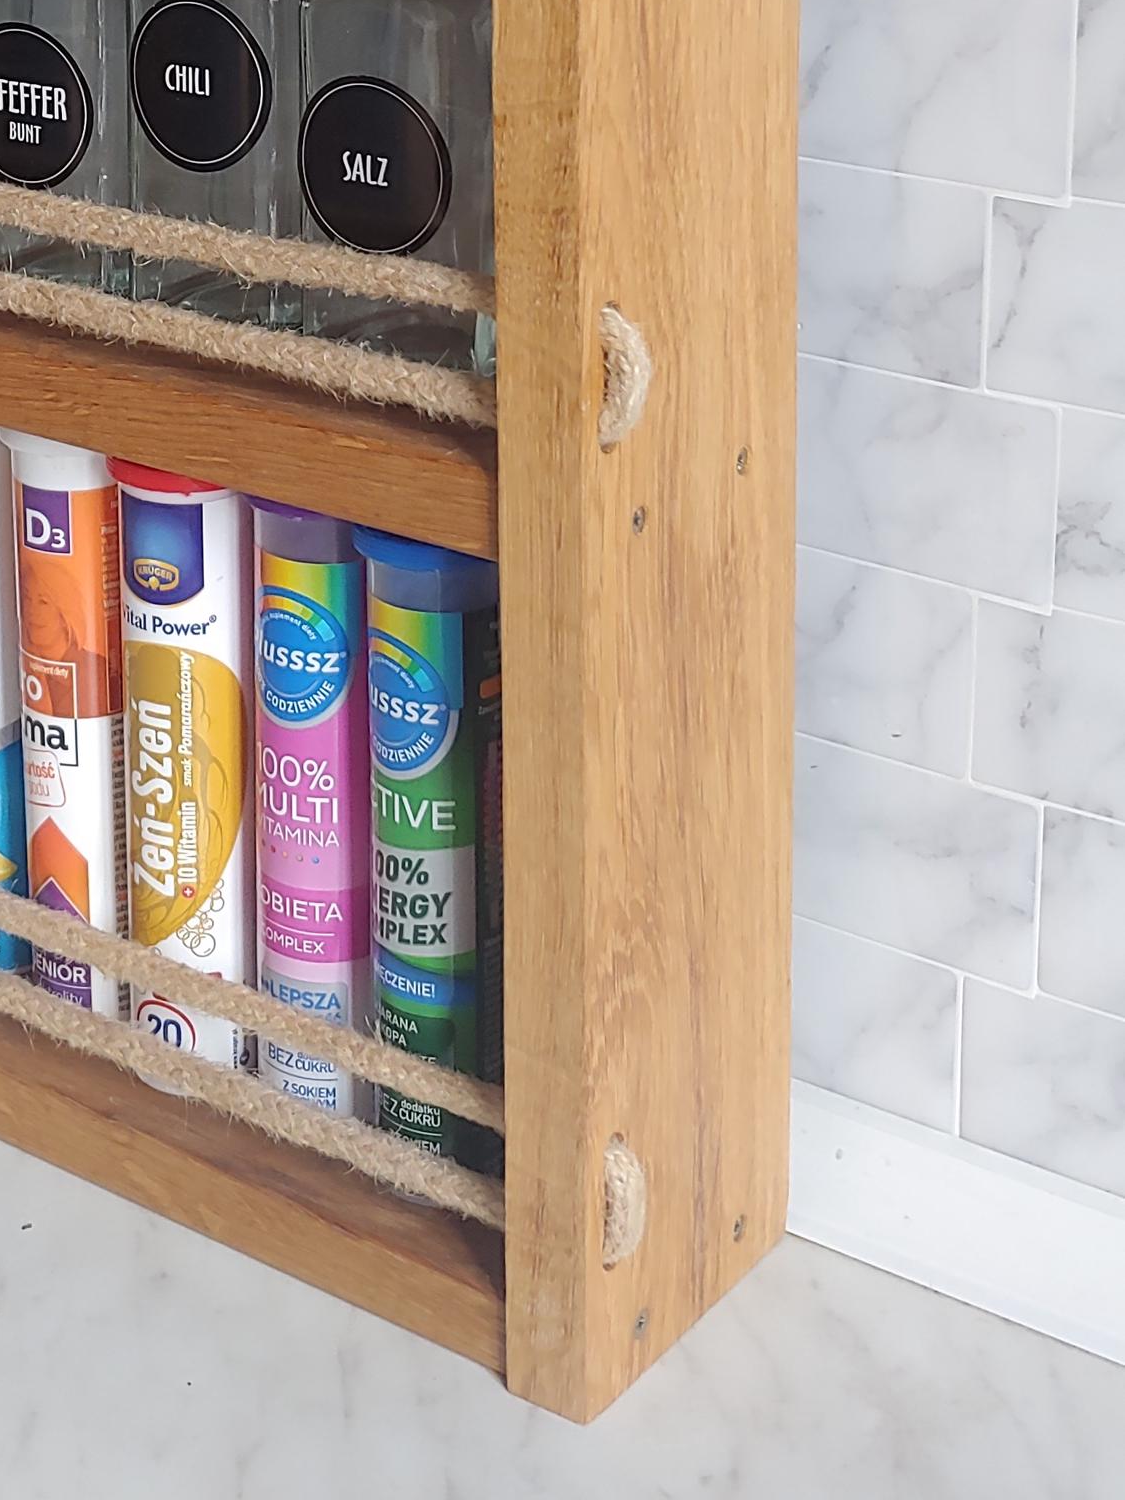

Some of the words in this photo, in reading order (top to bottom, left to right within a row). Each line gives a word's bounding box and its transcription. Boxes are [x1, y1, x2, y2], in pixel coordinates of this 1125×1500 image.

[164, 63, 211, 97] CHILI
[8, 120, 42, 145] BUNT
[341, 150, 389, 188] SALZ
[26, 507, 67, 550] D3
[124, 604, 148, 632] ital
[176, 651, 196, 756] Pomarańczowy
[266, 680, 336, 714] CODZIENNIE
[370, 683, 440, 726] usssz
[178, 757, 193, 787] smak
[131, 696, 175, 897] Zeń-Szeń
[376, 782, 457, 832] TIVE
[177, 801, 198, 867] Witamin
[178, 866, 198, 885] 10
[375, 848, 430, 886] 00%
[260, 884, 343, 922] OBIETA
[378, 885, 453, 920] ERGY
[263, 925, 325, 955] OMPLEX
[36, 950, 87, 984] ENIOR
[378, 964, 436, 998] ĘCZENIE!
[380, 1005, 418, 1035] ARANA
[268, 1041, 295, 1068] BEZ
[291, 1082, 337, 1100] SOKIEM
[382, 1092, 398, 1118] EZ
[398, 1107, 441, 1128] CUKRU
